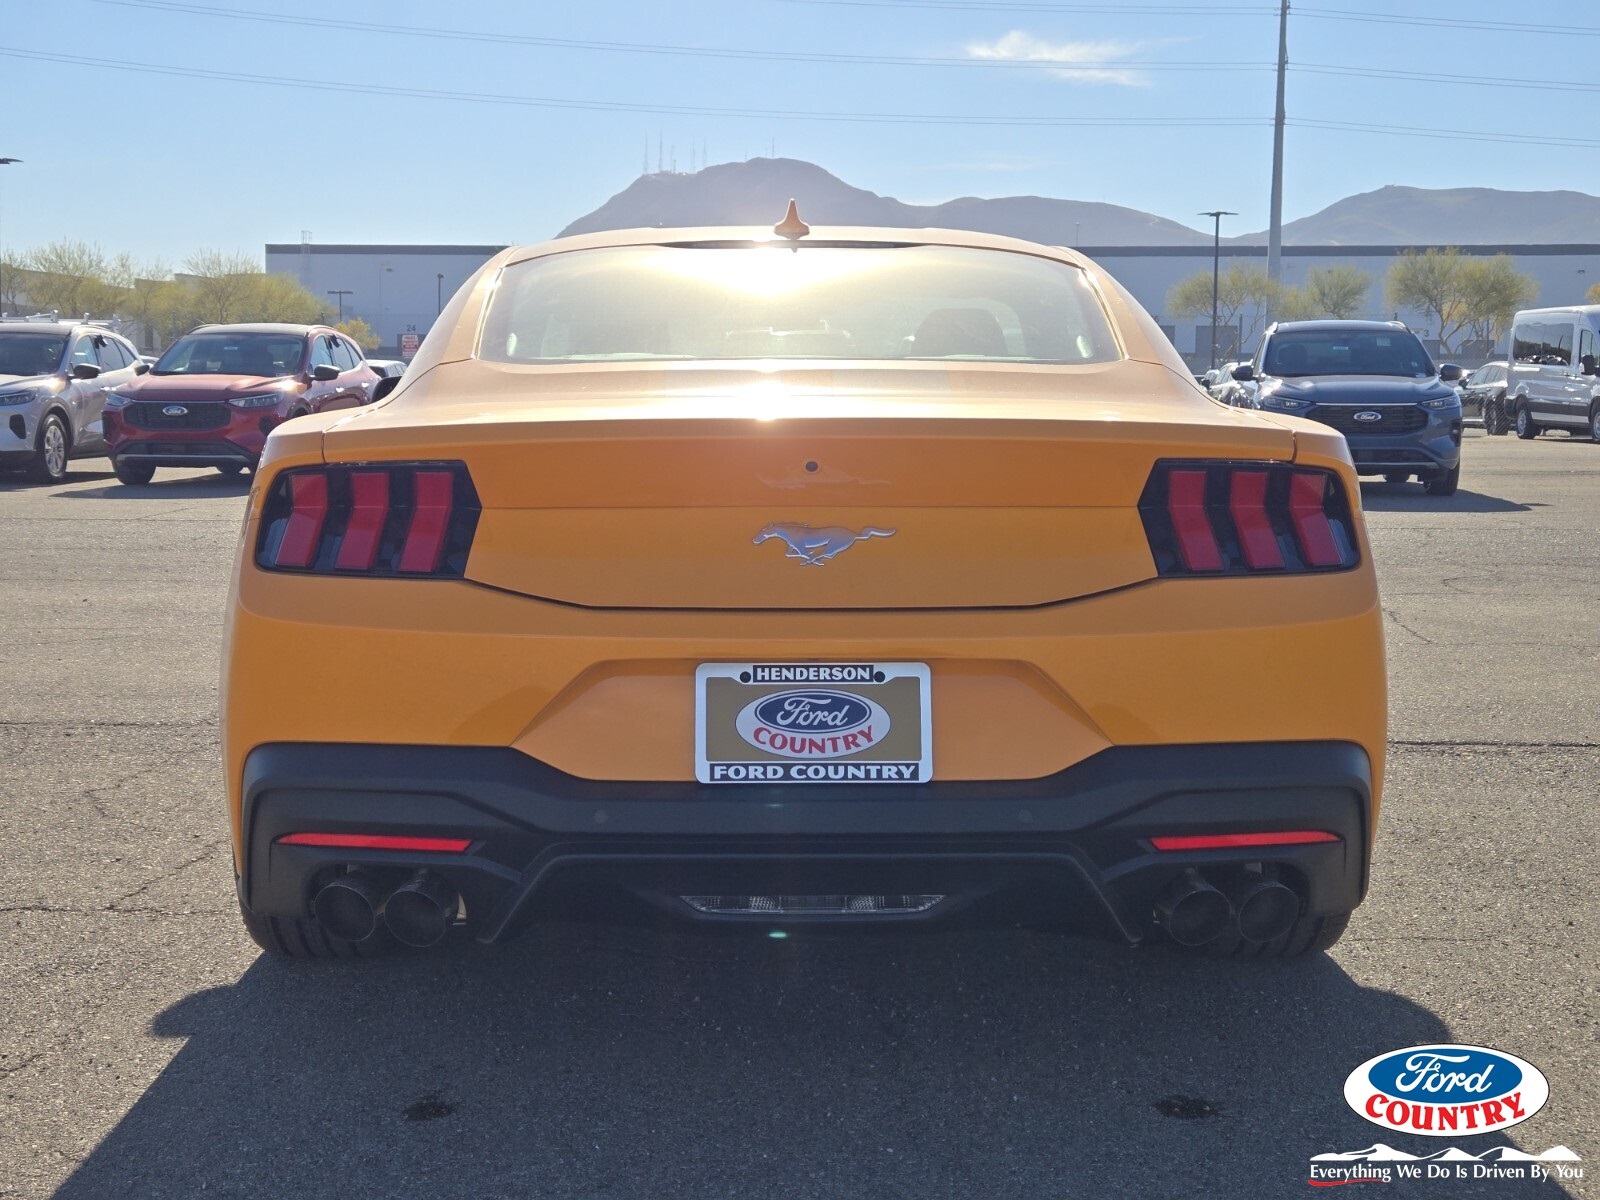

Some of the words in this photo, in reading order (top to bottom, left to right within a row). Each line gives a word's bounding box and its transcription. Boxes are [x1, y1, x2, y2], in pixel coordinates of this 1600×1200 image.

[406, 324, 416, 332] 24
[756, 667, 871, 681] HENDERSON
[776, 697, 850, 726] Ford
[753, 725, 875, 754] COUNTRY
[713, 765, 784, 779] FORD
[789, 765, 916, 779] COUNTRY
